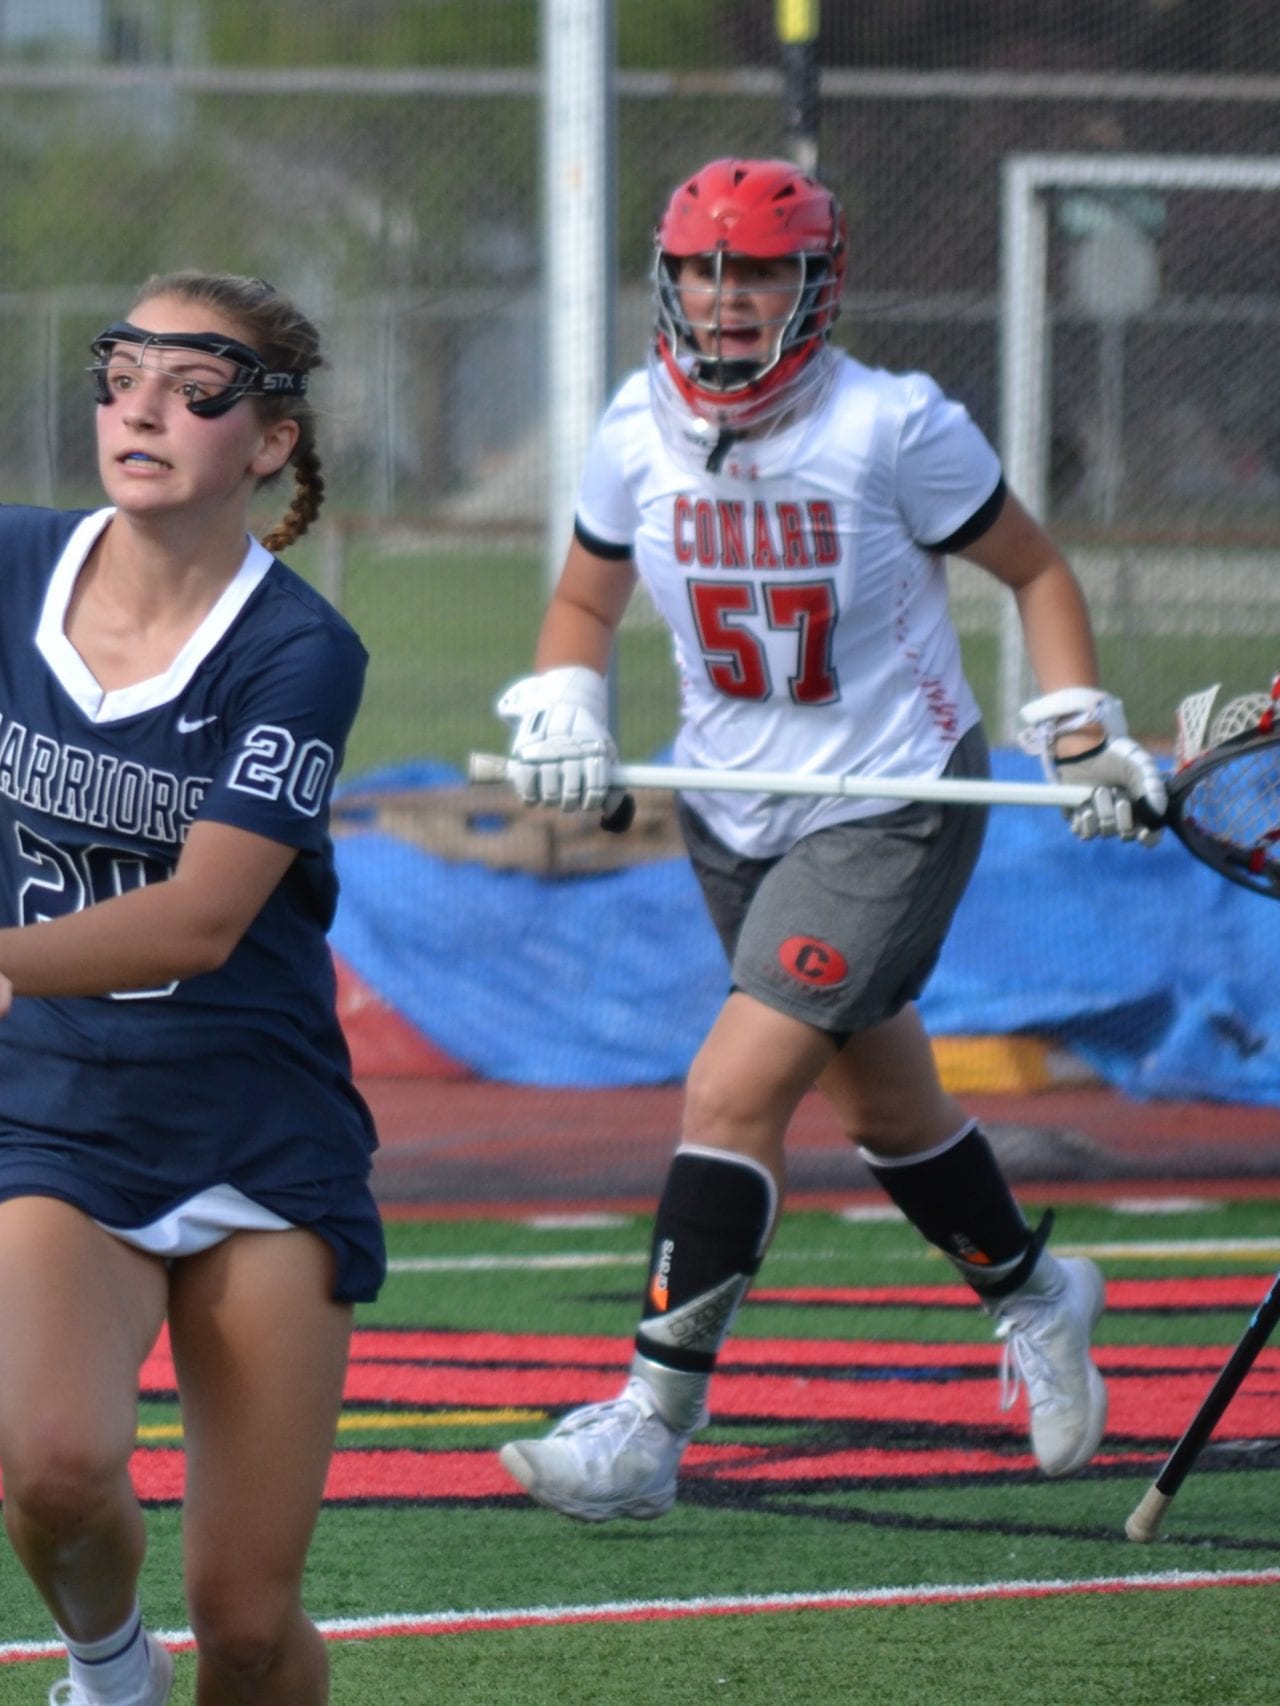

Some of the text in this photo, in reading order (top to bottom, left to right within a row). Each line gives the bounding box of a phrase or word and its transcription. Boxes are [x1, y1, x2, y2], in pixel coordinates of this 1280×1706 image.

[262, 373, 294, 390] STX
[673, 495, 842, 569] CONARD
[686, 577, 841, 706] 57
[227, 724, 335, 818] 20
[795, 943, 830, 978] C
